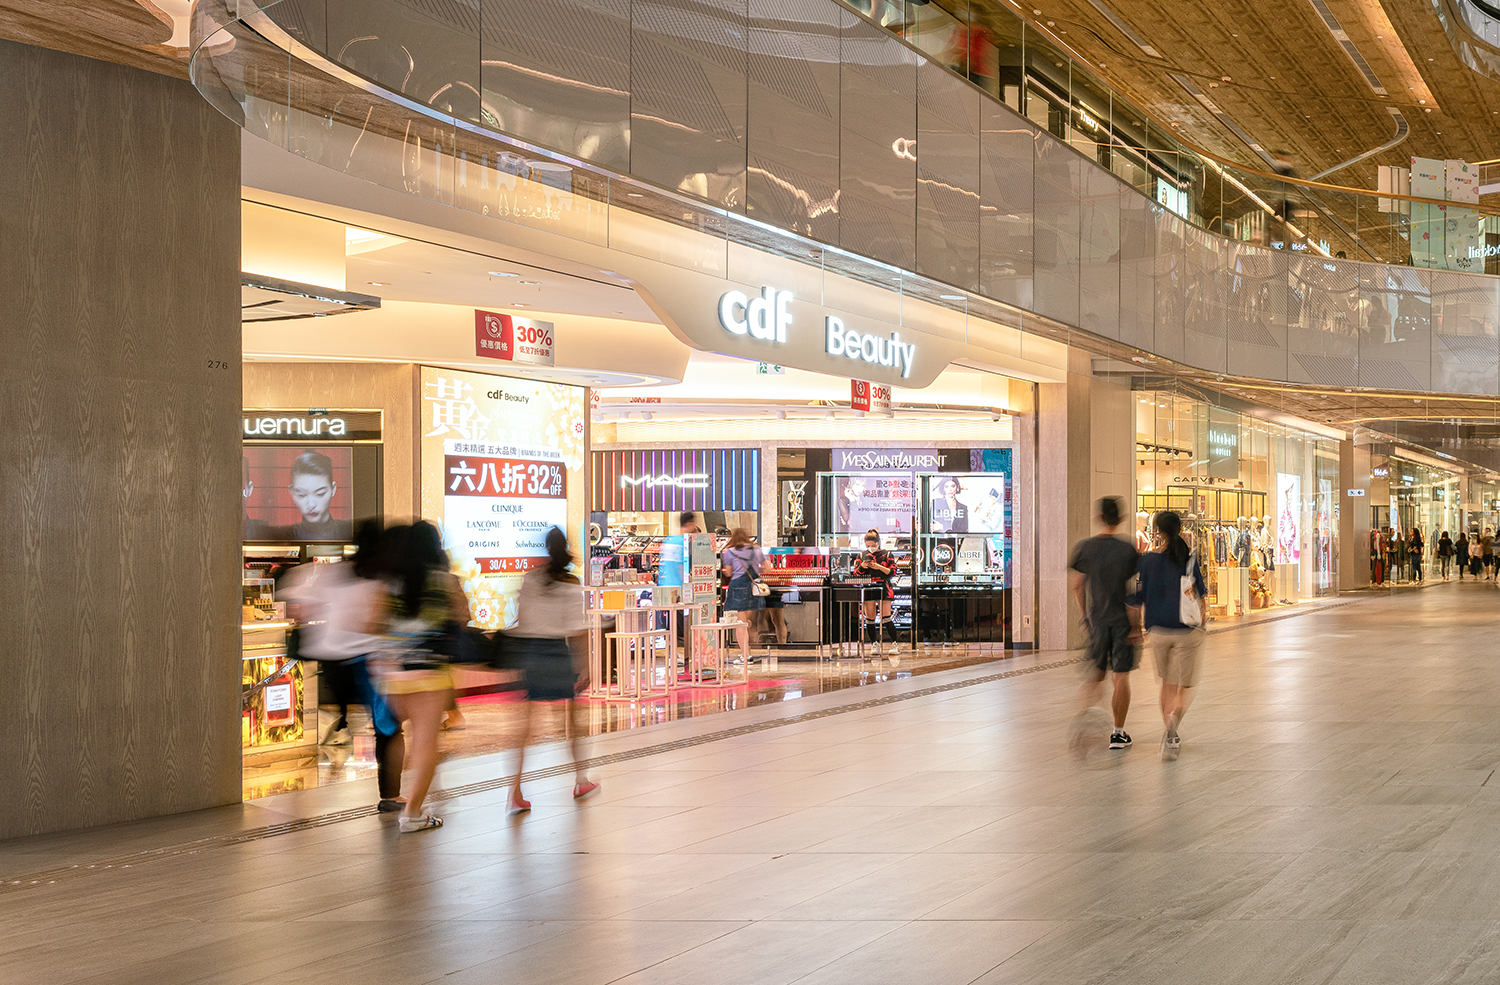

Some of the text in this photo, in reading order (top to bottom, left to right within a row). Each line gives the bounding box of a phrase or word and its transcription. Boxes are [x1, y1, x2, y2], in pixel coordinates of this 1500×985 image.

[1079, 109, 1099, 132] Theory
[516, 325, 553, 347] 30%
[717, 285, 916, 379] cdf Beauty
[207, 359, 228, 370] 276
[486, 389, 530, 404] cdf Beauty
[871, 386, 891, 401] 30%
[243, 417, 346, 436] uemura
[449, 459, 527, 495] 六八折
[550, 484, 562, 496] OFF
[491, 504, 524, 514] CLINIQUE
[934, 508, 965, 519] LIBRE
[466, 519, 501, 528] LANCÔME
[468, 540, 500, 548] ORIGINS
[489, 558, 507, 571] 30/4
[515, 558, 528, 570] 3/5
